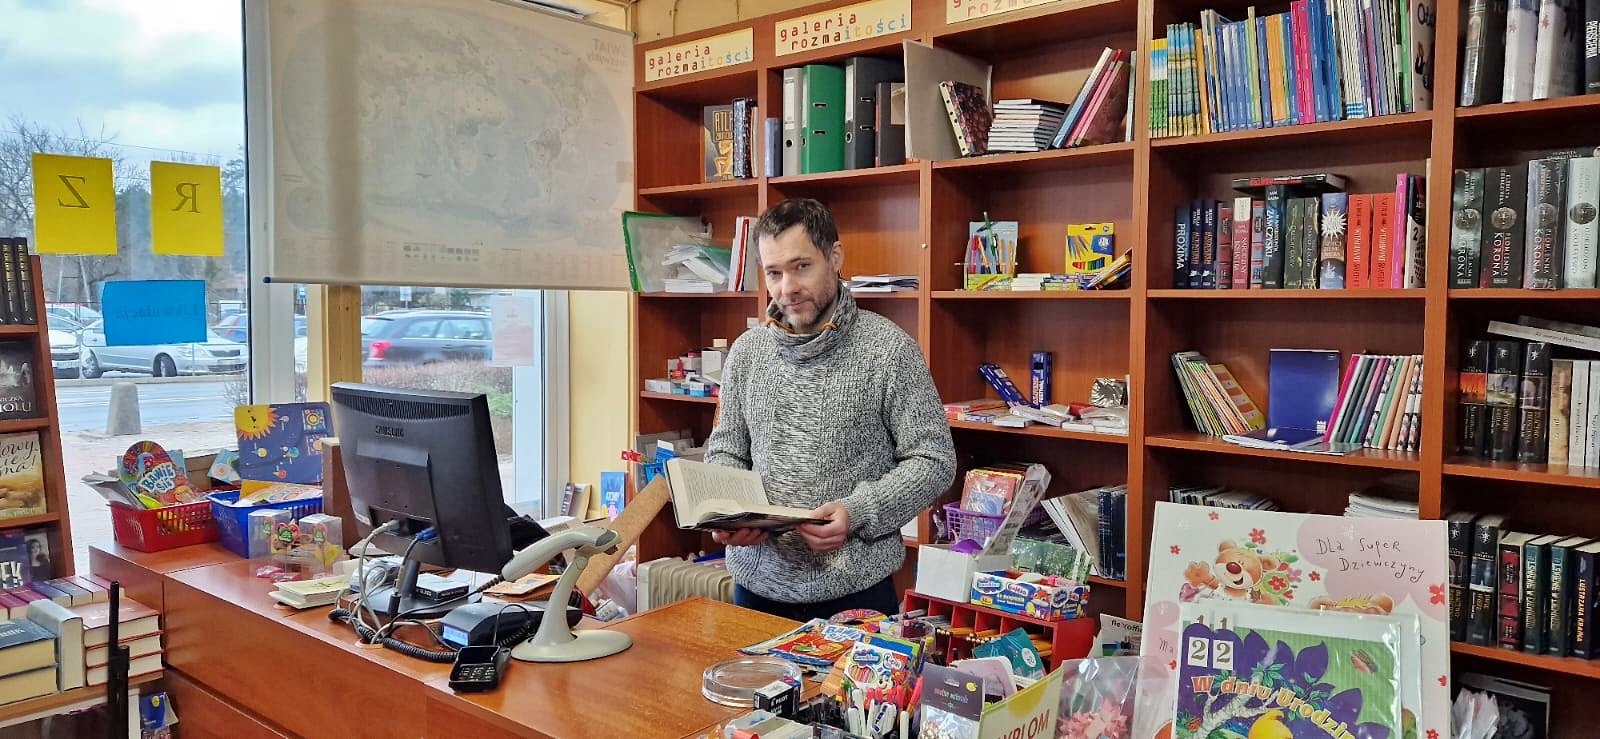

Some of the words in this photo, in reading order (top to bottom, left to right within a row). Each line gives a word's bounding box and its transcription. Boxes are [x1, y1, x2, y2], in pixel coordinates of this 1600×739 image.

[780, 12, 857, 42] galeria
[791, 14, 907, 51] rozmaitości
[648, 44, 711, 69] galeria
[657, 47, 751, 78] rozmaitości
[1176, 223, 1186, 270] PROXIMA
[1265, 209, 1274, 257] ZAMCZYSKU
[1492, 232, 1503, 277] KORONA
[1533, 228, 1543, 274] KORONA
[375, 425, 404, 438] SAMSUNG
[1339, 557, 1425, 583] Dziewczyny
[1577, 578, 1586, 616] LUSTRZANA
[1575, 617, 1585, 642] KRAINA
[1191, 640, 1206, 661] 2
[1217, 642, 1231, 664] 2
[1191, 676, 1214, 693] W
[1221, 677, 1272, 700] dniu
[997, 709, 1050, 739] YPLOM
